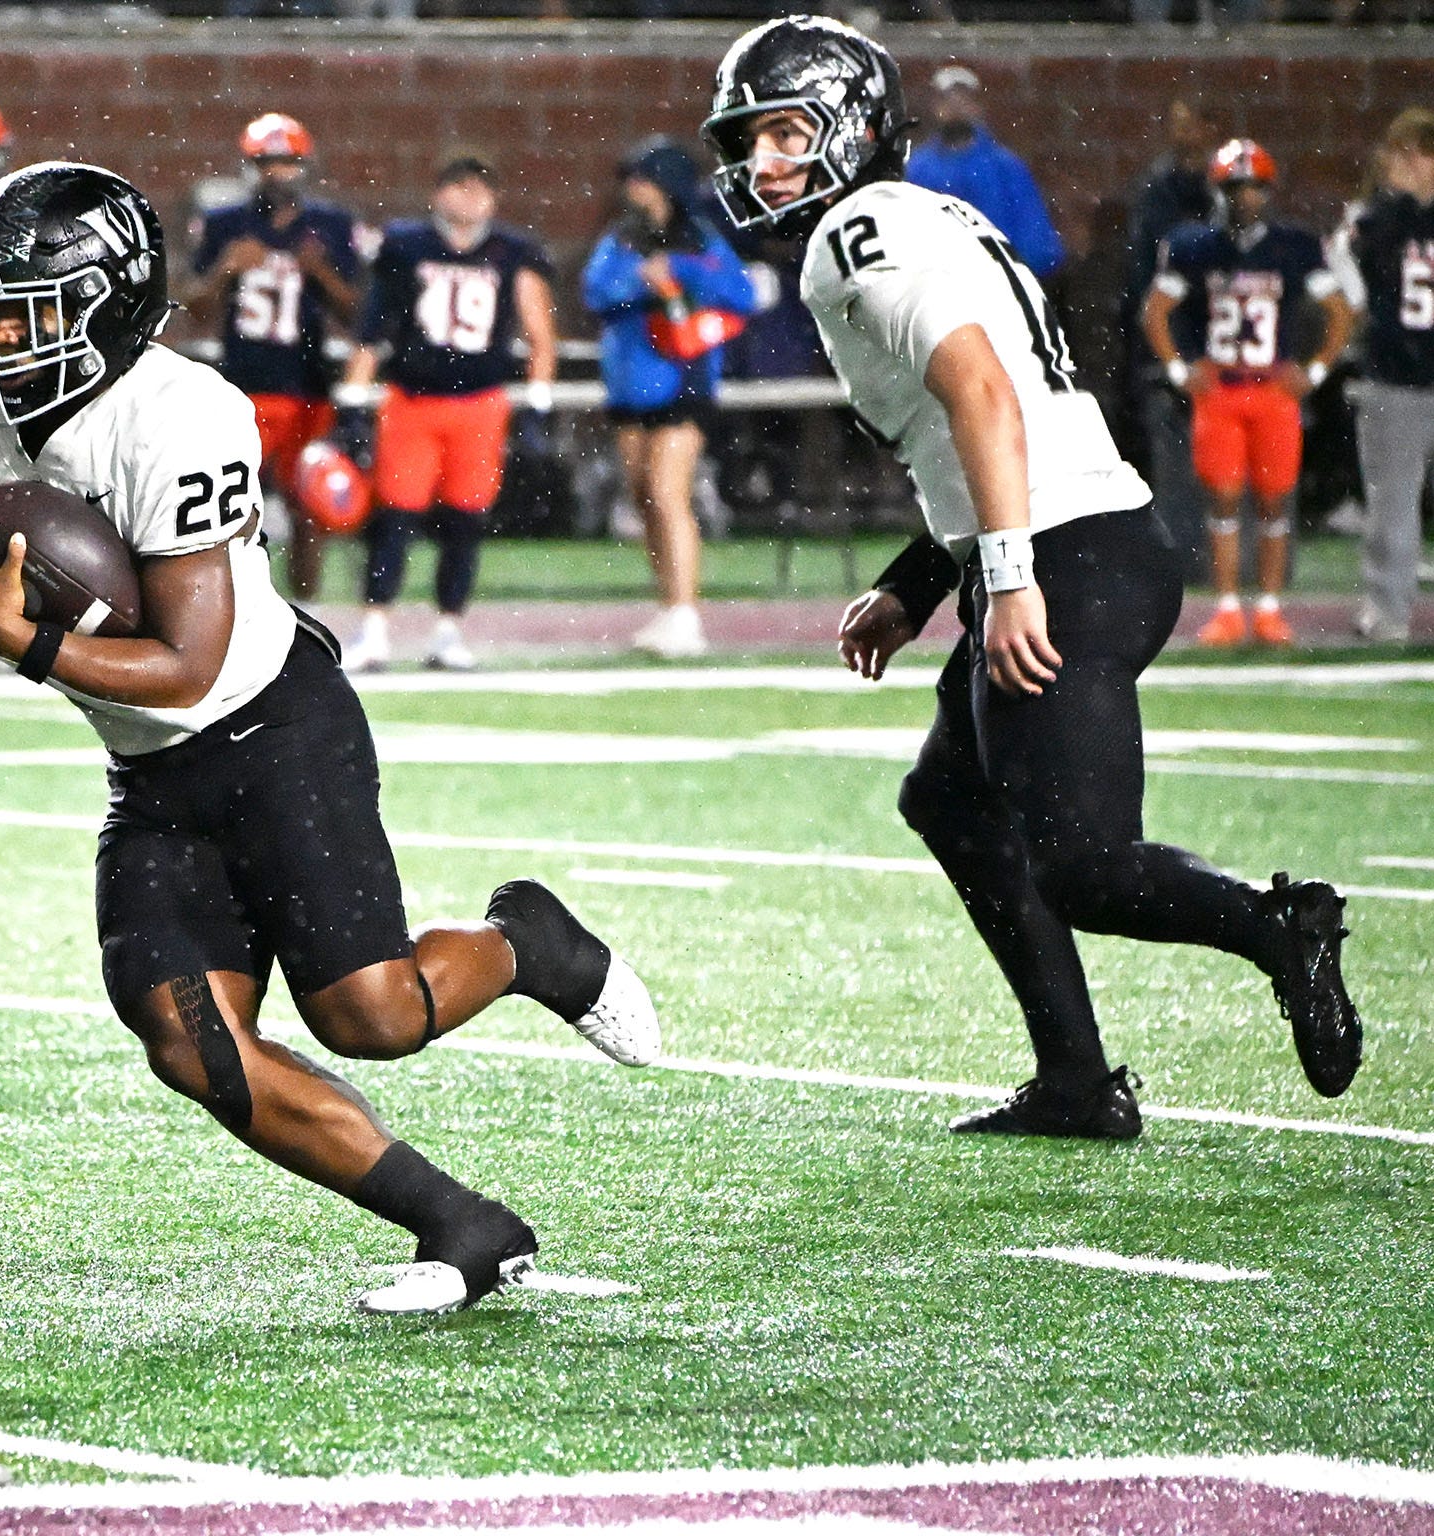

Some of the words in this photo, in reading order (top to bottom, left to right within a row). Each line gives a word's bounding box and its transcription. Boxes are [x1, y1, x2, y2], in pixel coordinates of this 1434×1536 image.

[826, 214, 886, 280] 12
[235, 264, 302, 343] 51
[1206, 296, 1278, 367] 23
[174, 460, 250, 537] 22
